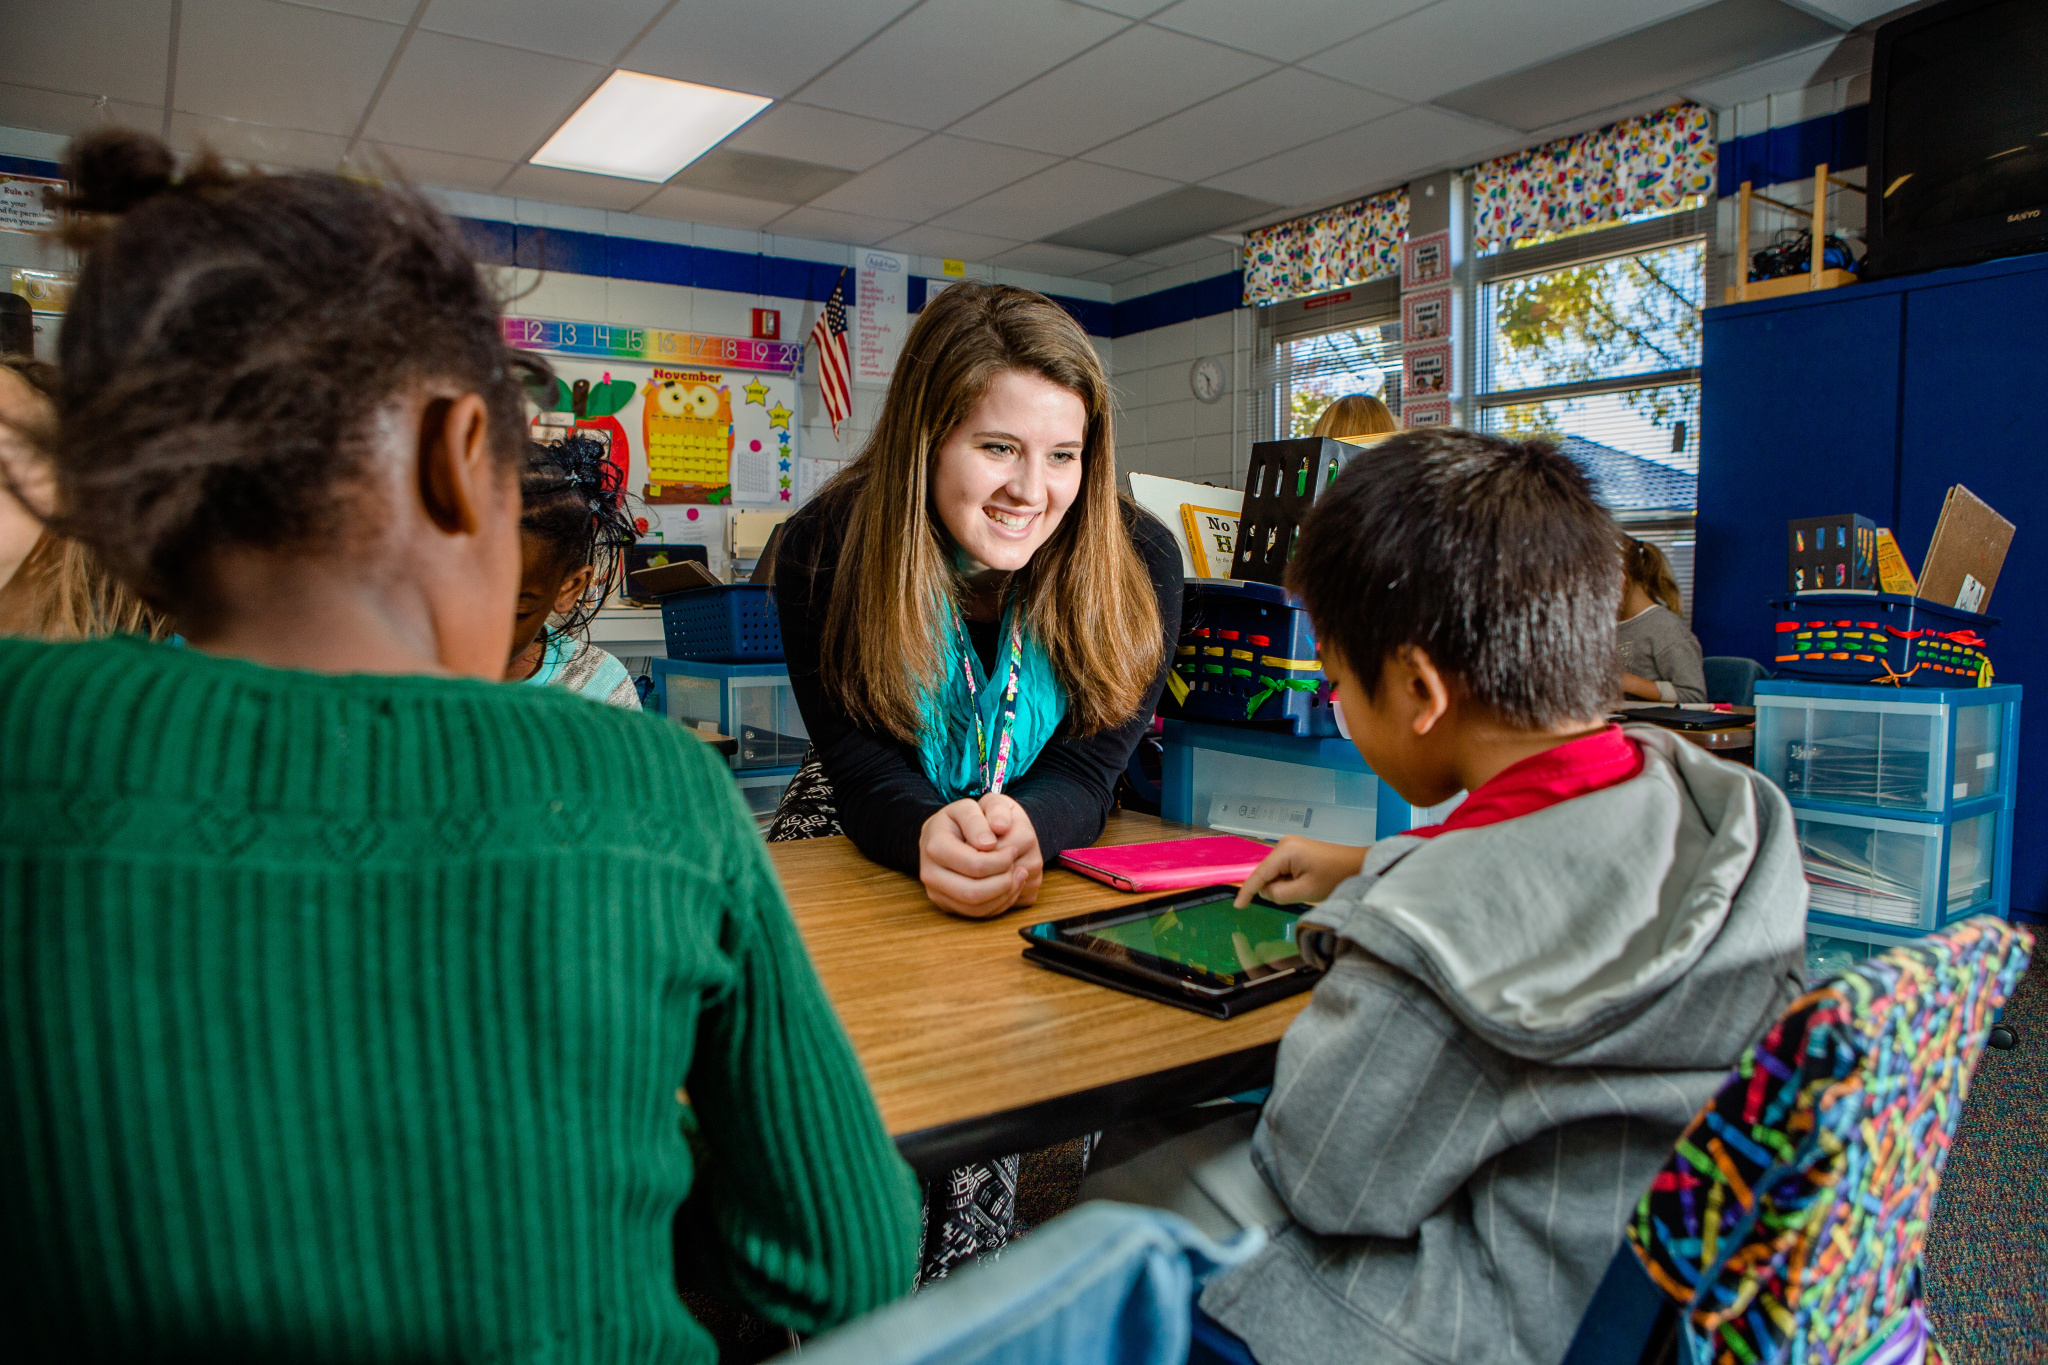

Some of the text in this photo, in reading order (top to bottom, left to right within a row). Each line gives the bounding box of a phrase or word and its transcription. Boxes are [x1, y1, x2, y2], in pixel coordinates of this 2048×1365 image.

[4, 187, 22, 196] Rule
[2007, 210, 2041, 222] SANYO
[1416, 305, 1433, 314] Level
[524, 320, 543, 342] 12
[560, 323, 577, 345] 13
[593, 326, 610, 348] 14
[626, 329, 643, 350] 15
[658, 332, 676, 353] 16
[690, 335, 707, 356] 17
[721, 338, 738, 360] 18
[751, 341, 768, 362] 19
[779, 344, 800, 365] 20
[1417, 358, 1434, 367] Level
[654, 369, 721, 383] November
[1416, 415, 1433, 423] Level
[1206, 516, 1230, 532] No
